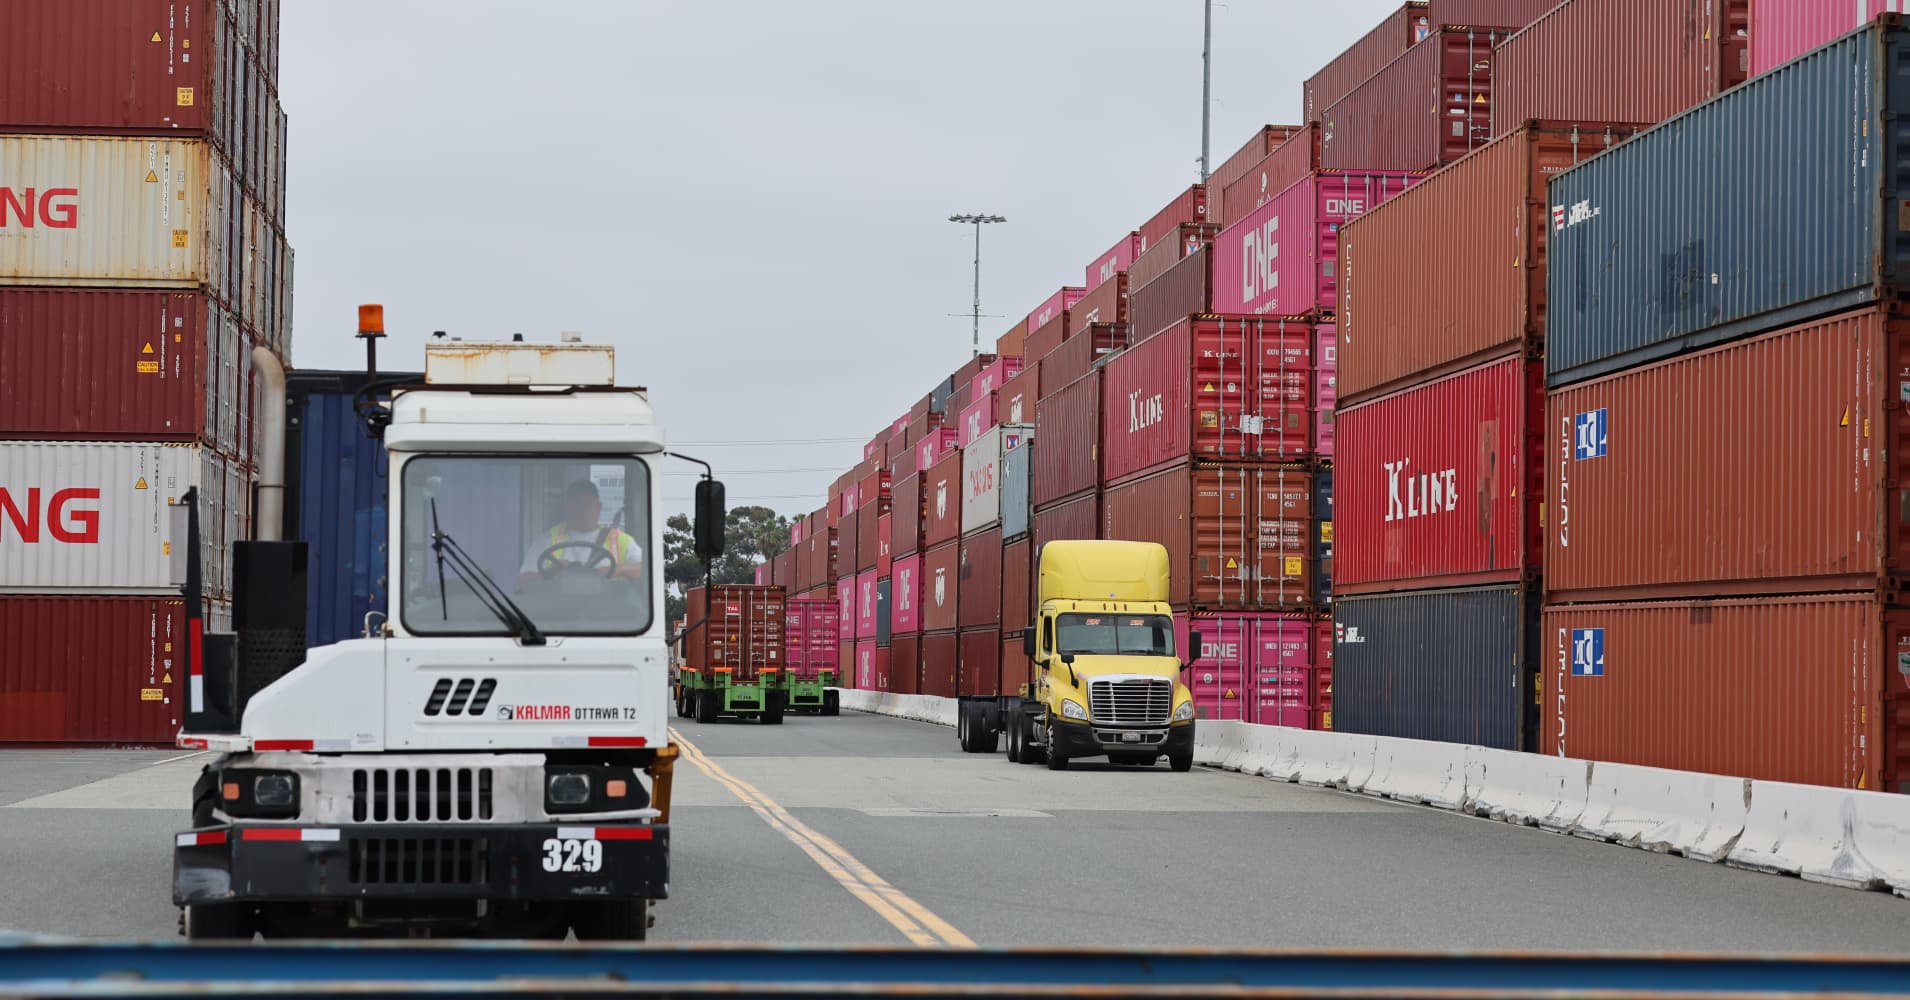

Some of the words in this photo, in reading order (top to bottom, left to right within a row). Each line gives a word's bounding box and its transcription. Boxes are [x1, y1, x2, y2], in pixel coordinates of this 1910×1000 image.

[1326, 199, 1363, 213] ONE
[1243, 216, 1278, 303] ONE
[0, 487, 100, 544] NG
[786, 616, 799, 624] NE
[1201, 643, 1237, 657] ONE
[516, 705, 571, 720] KALMAR
[575, 708, 619, 720] OTTAWA
[623, 708, 637, 720] T2
[542, 838, 603, 873] 329
